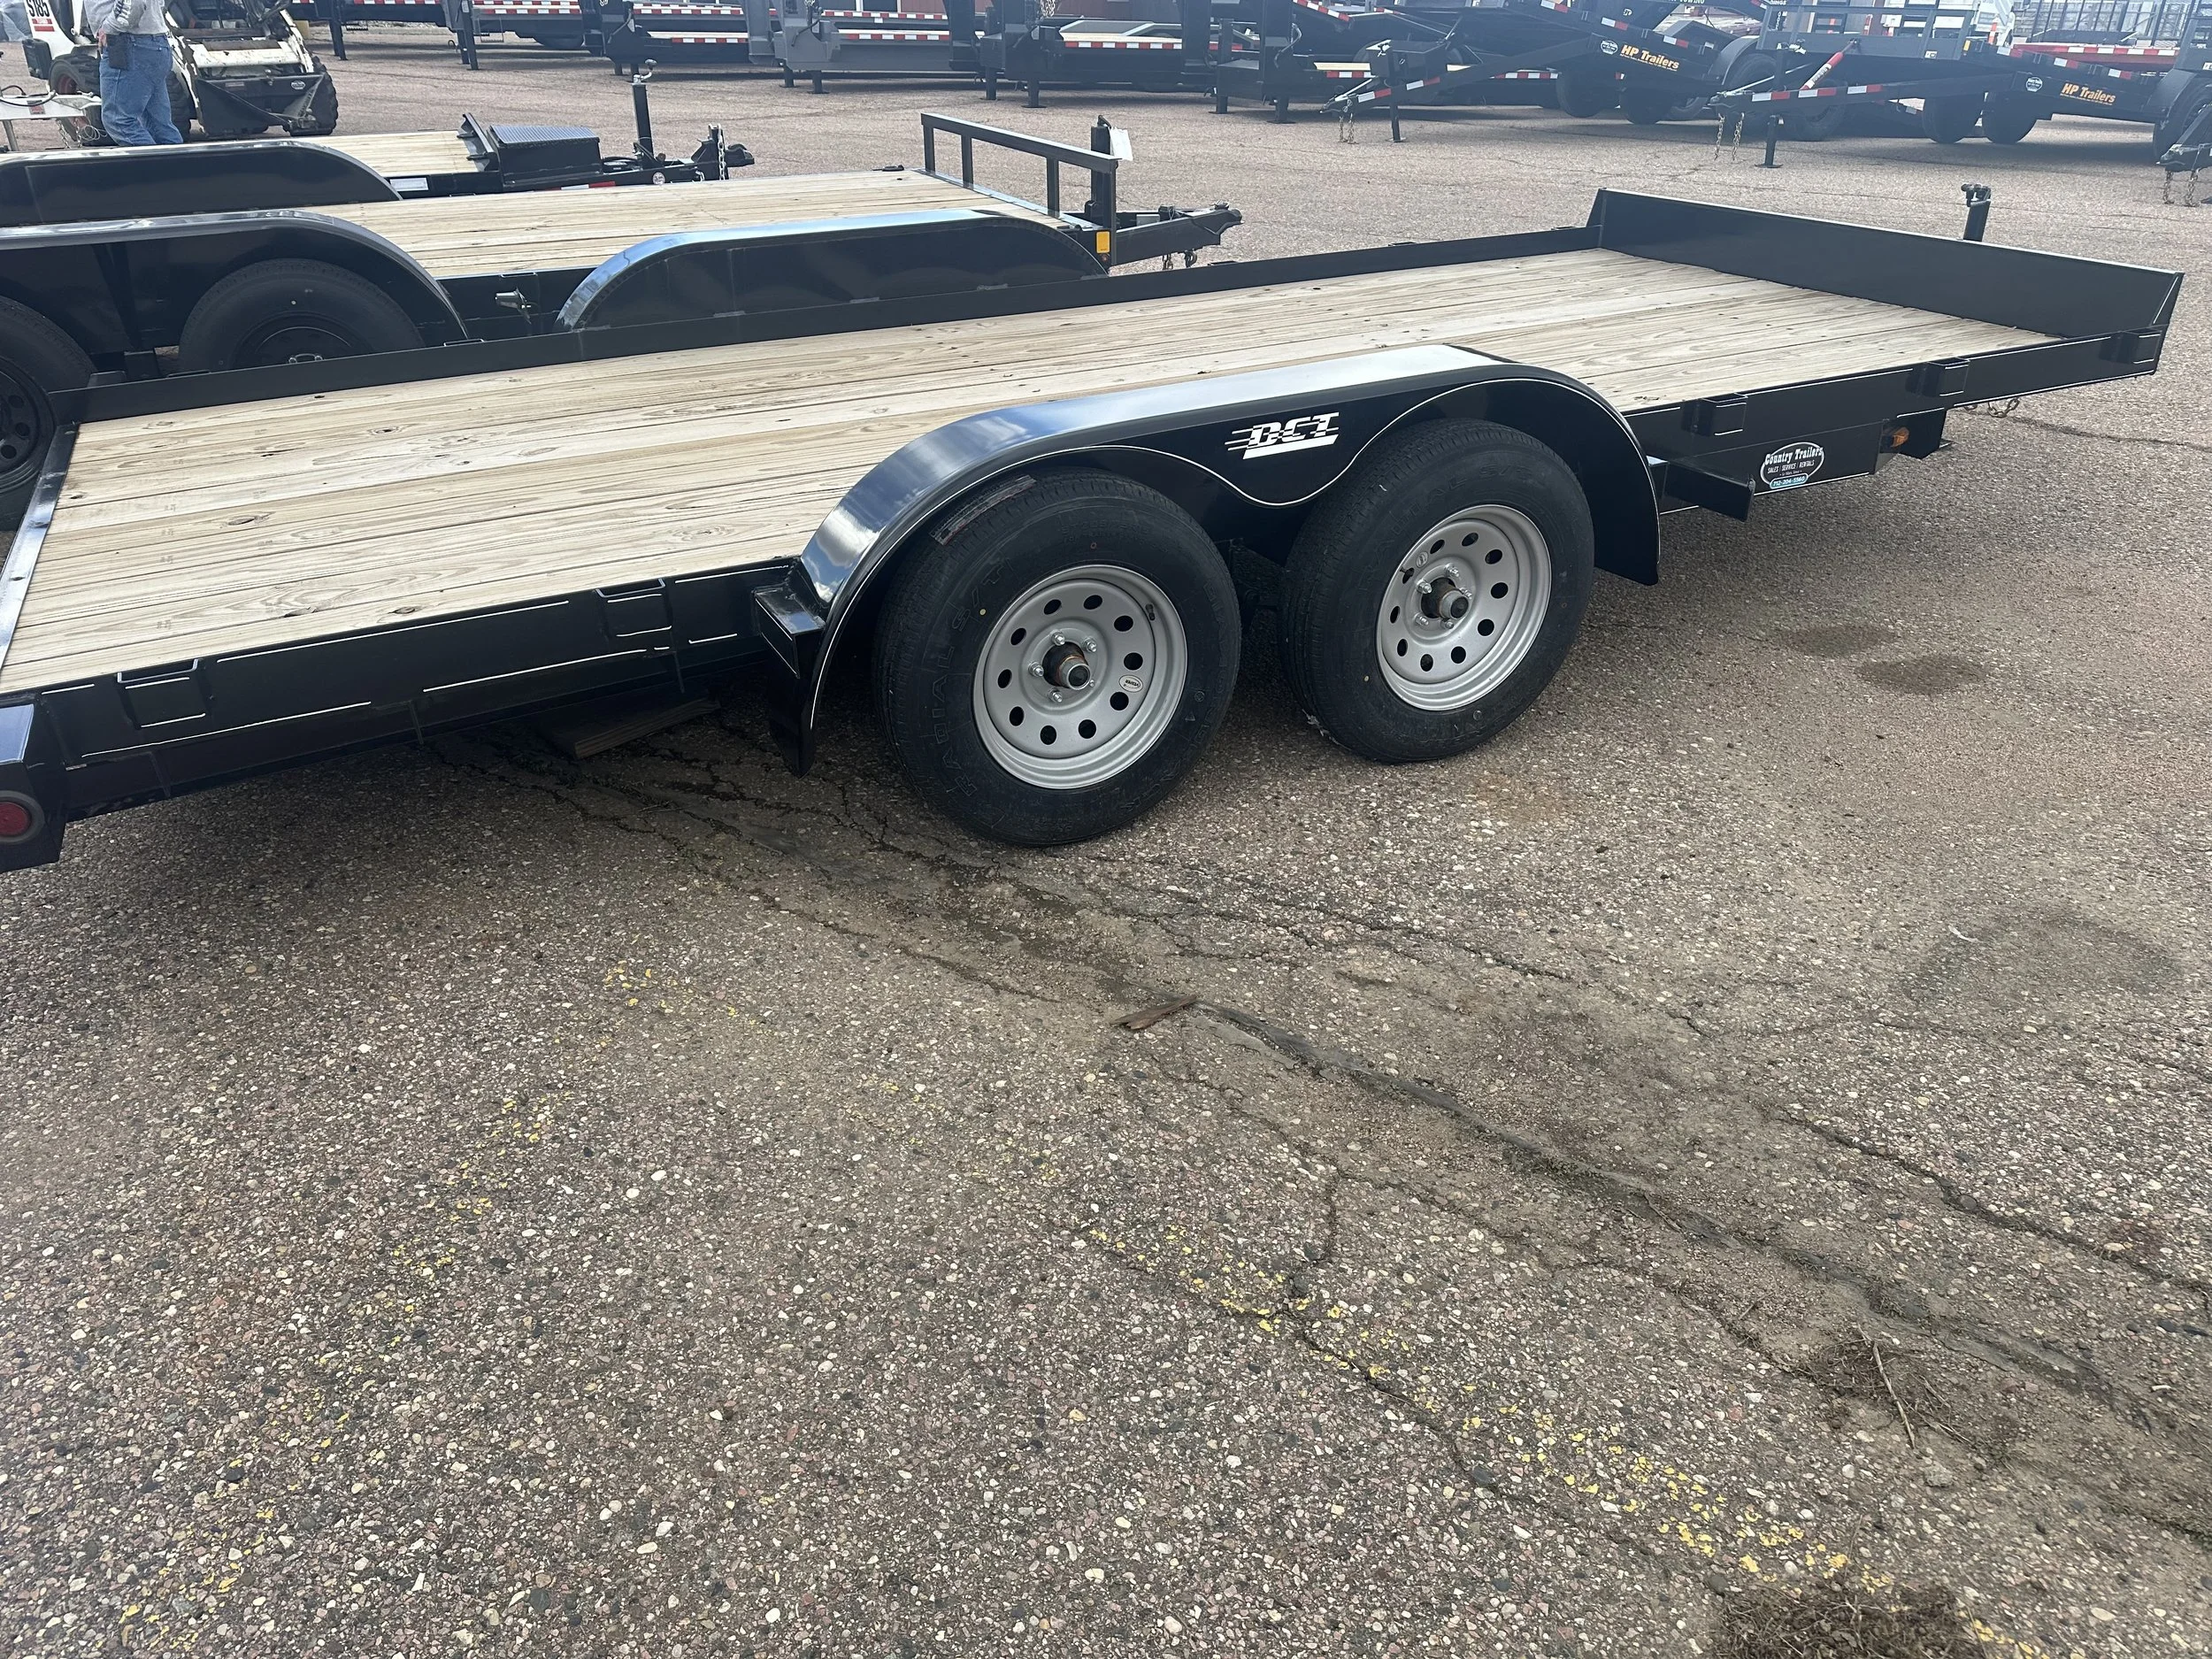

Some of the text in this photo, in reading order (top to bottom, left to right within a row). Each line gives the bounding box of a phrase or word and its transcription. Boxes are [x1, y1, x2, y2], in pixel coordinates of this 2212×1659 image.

[28, 0, 50, 17] S185
[1621, 44, 1640, 57] HP
[1640, 50, 1680, 69] Trailers
[2061, 82, 2079, 96] HP
[2079, 86, 2116, 104] Trailers
[1764, 446, 1824, 465] Country Trailers
[1767, 465, 1779, 474] SALES
[1781, 462, 1797, 472] SERVICE
